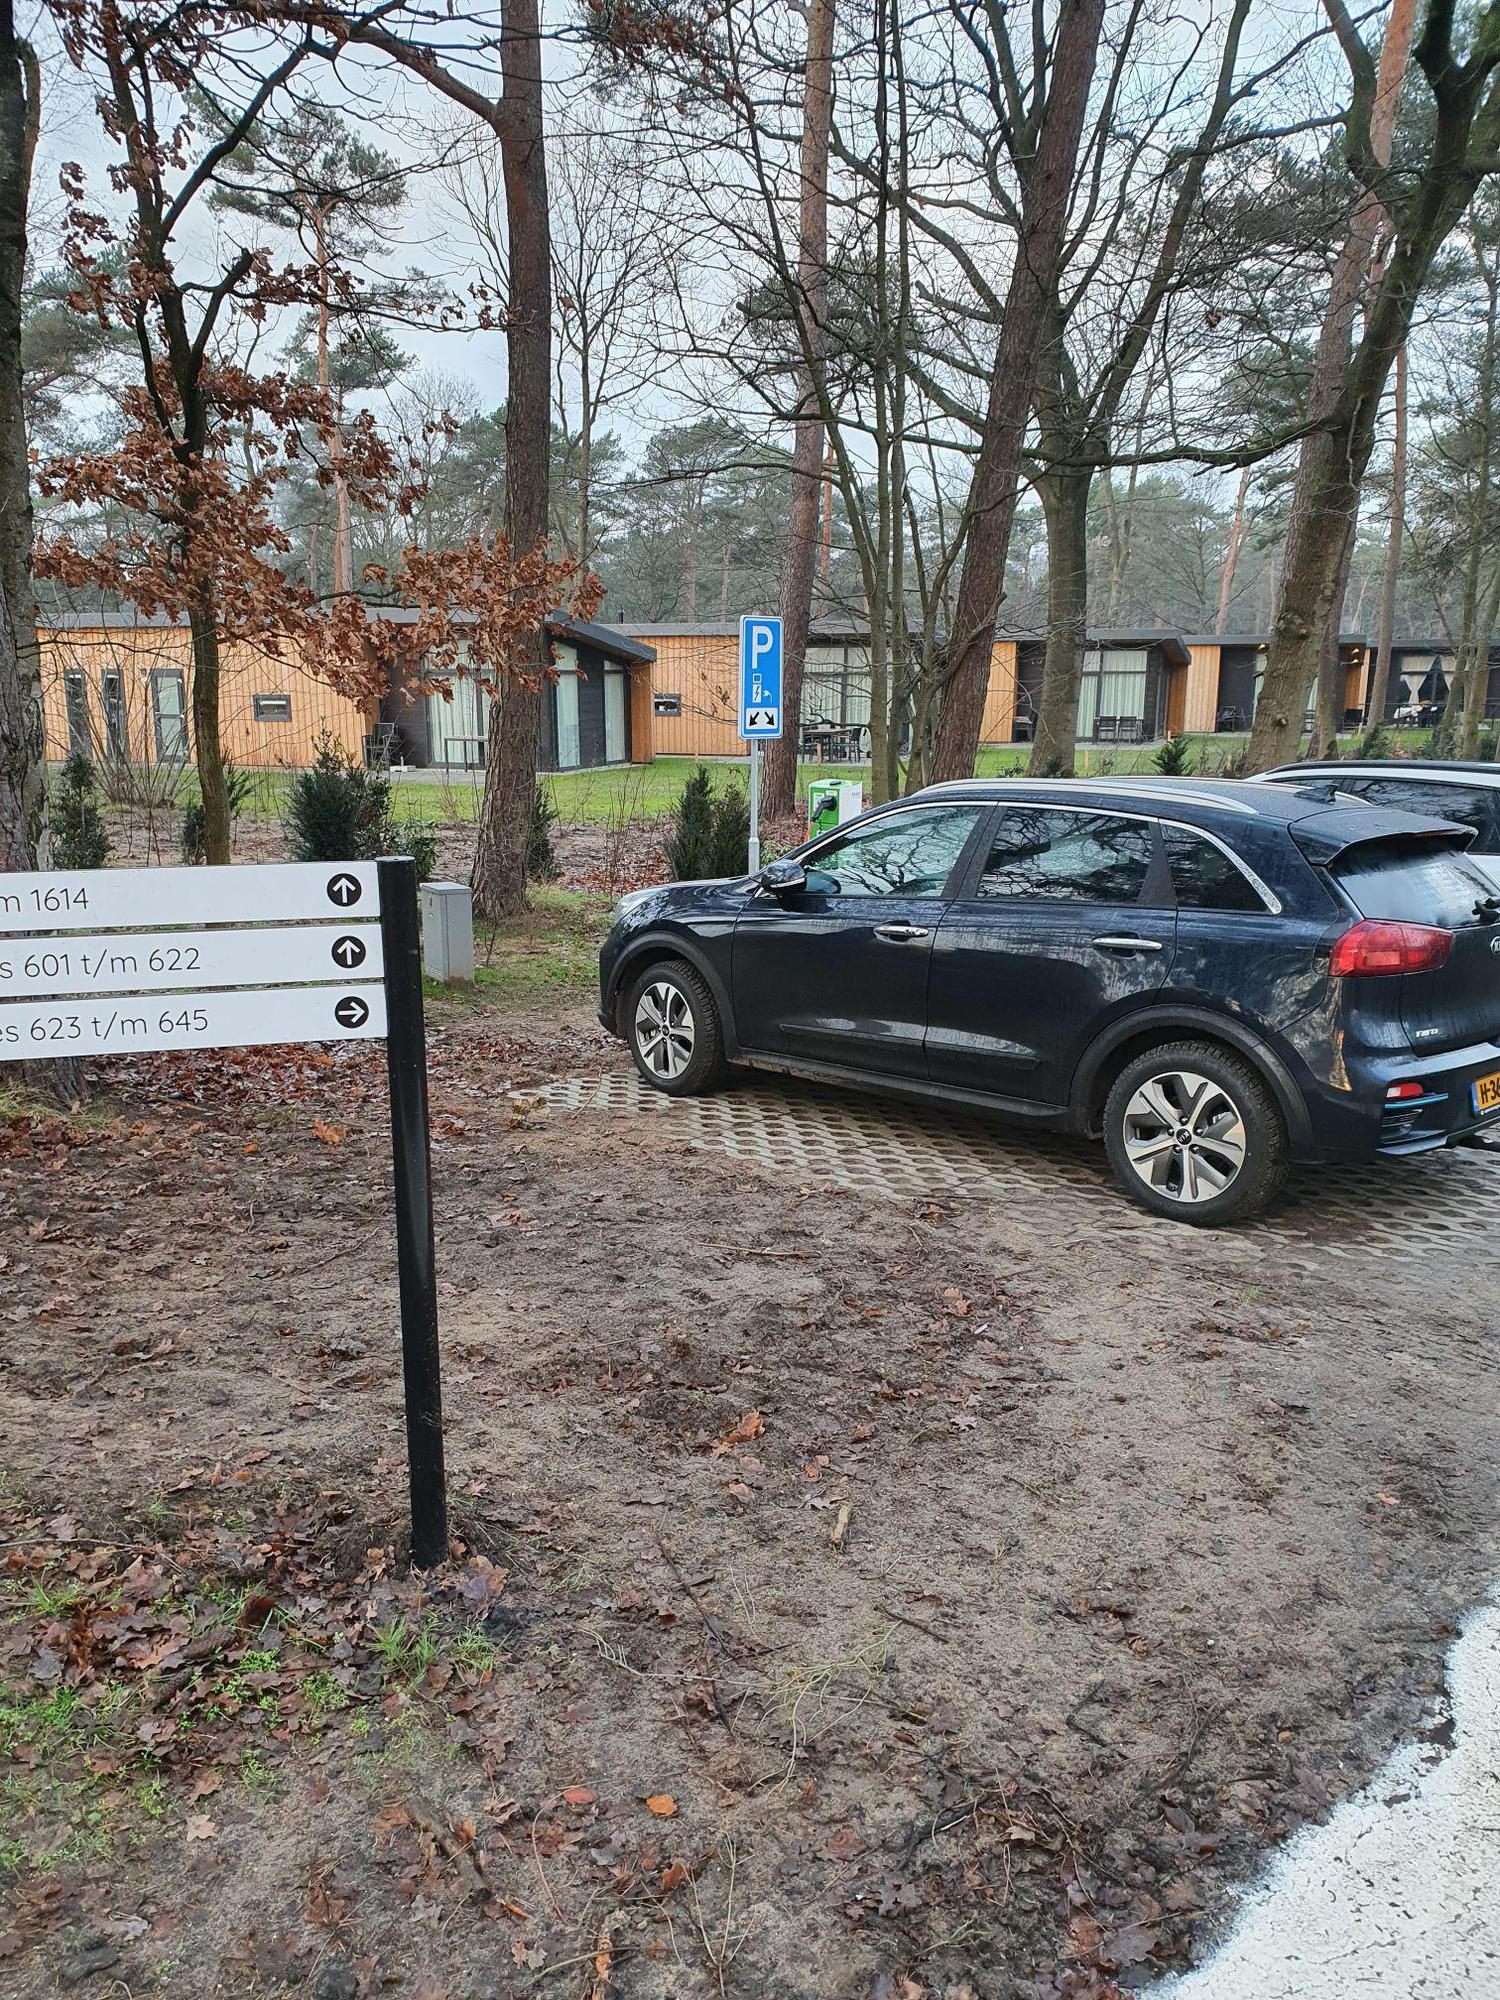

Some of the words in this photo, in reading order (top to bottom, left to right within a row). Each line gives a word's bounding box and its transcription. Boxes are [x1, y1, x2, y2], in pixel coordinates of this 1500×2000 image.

[751, 625, 774, 669] P
[30, 887, 89, 912] 1614
[24, 953, 70, 977] 601
[80, 949, 137, 978] t/m
[149, 947, 201, 971] 622
[30, 1016, 81, 1040] 623
[91, 1011, 147, 1040] t/m
[159, 1009, 208, 1033] 645
